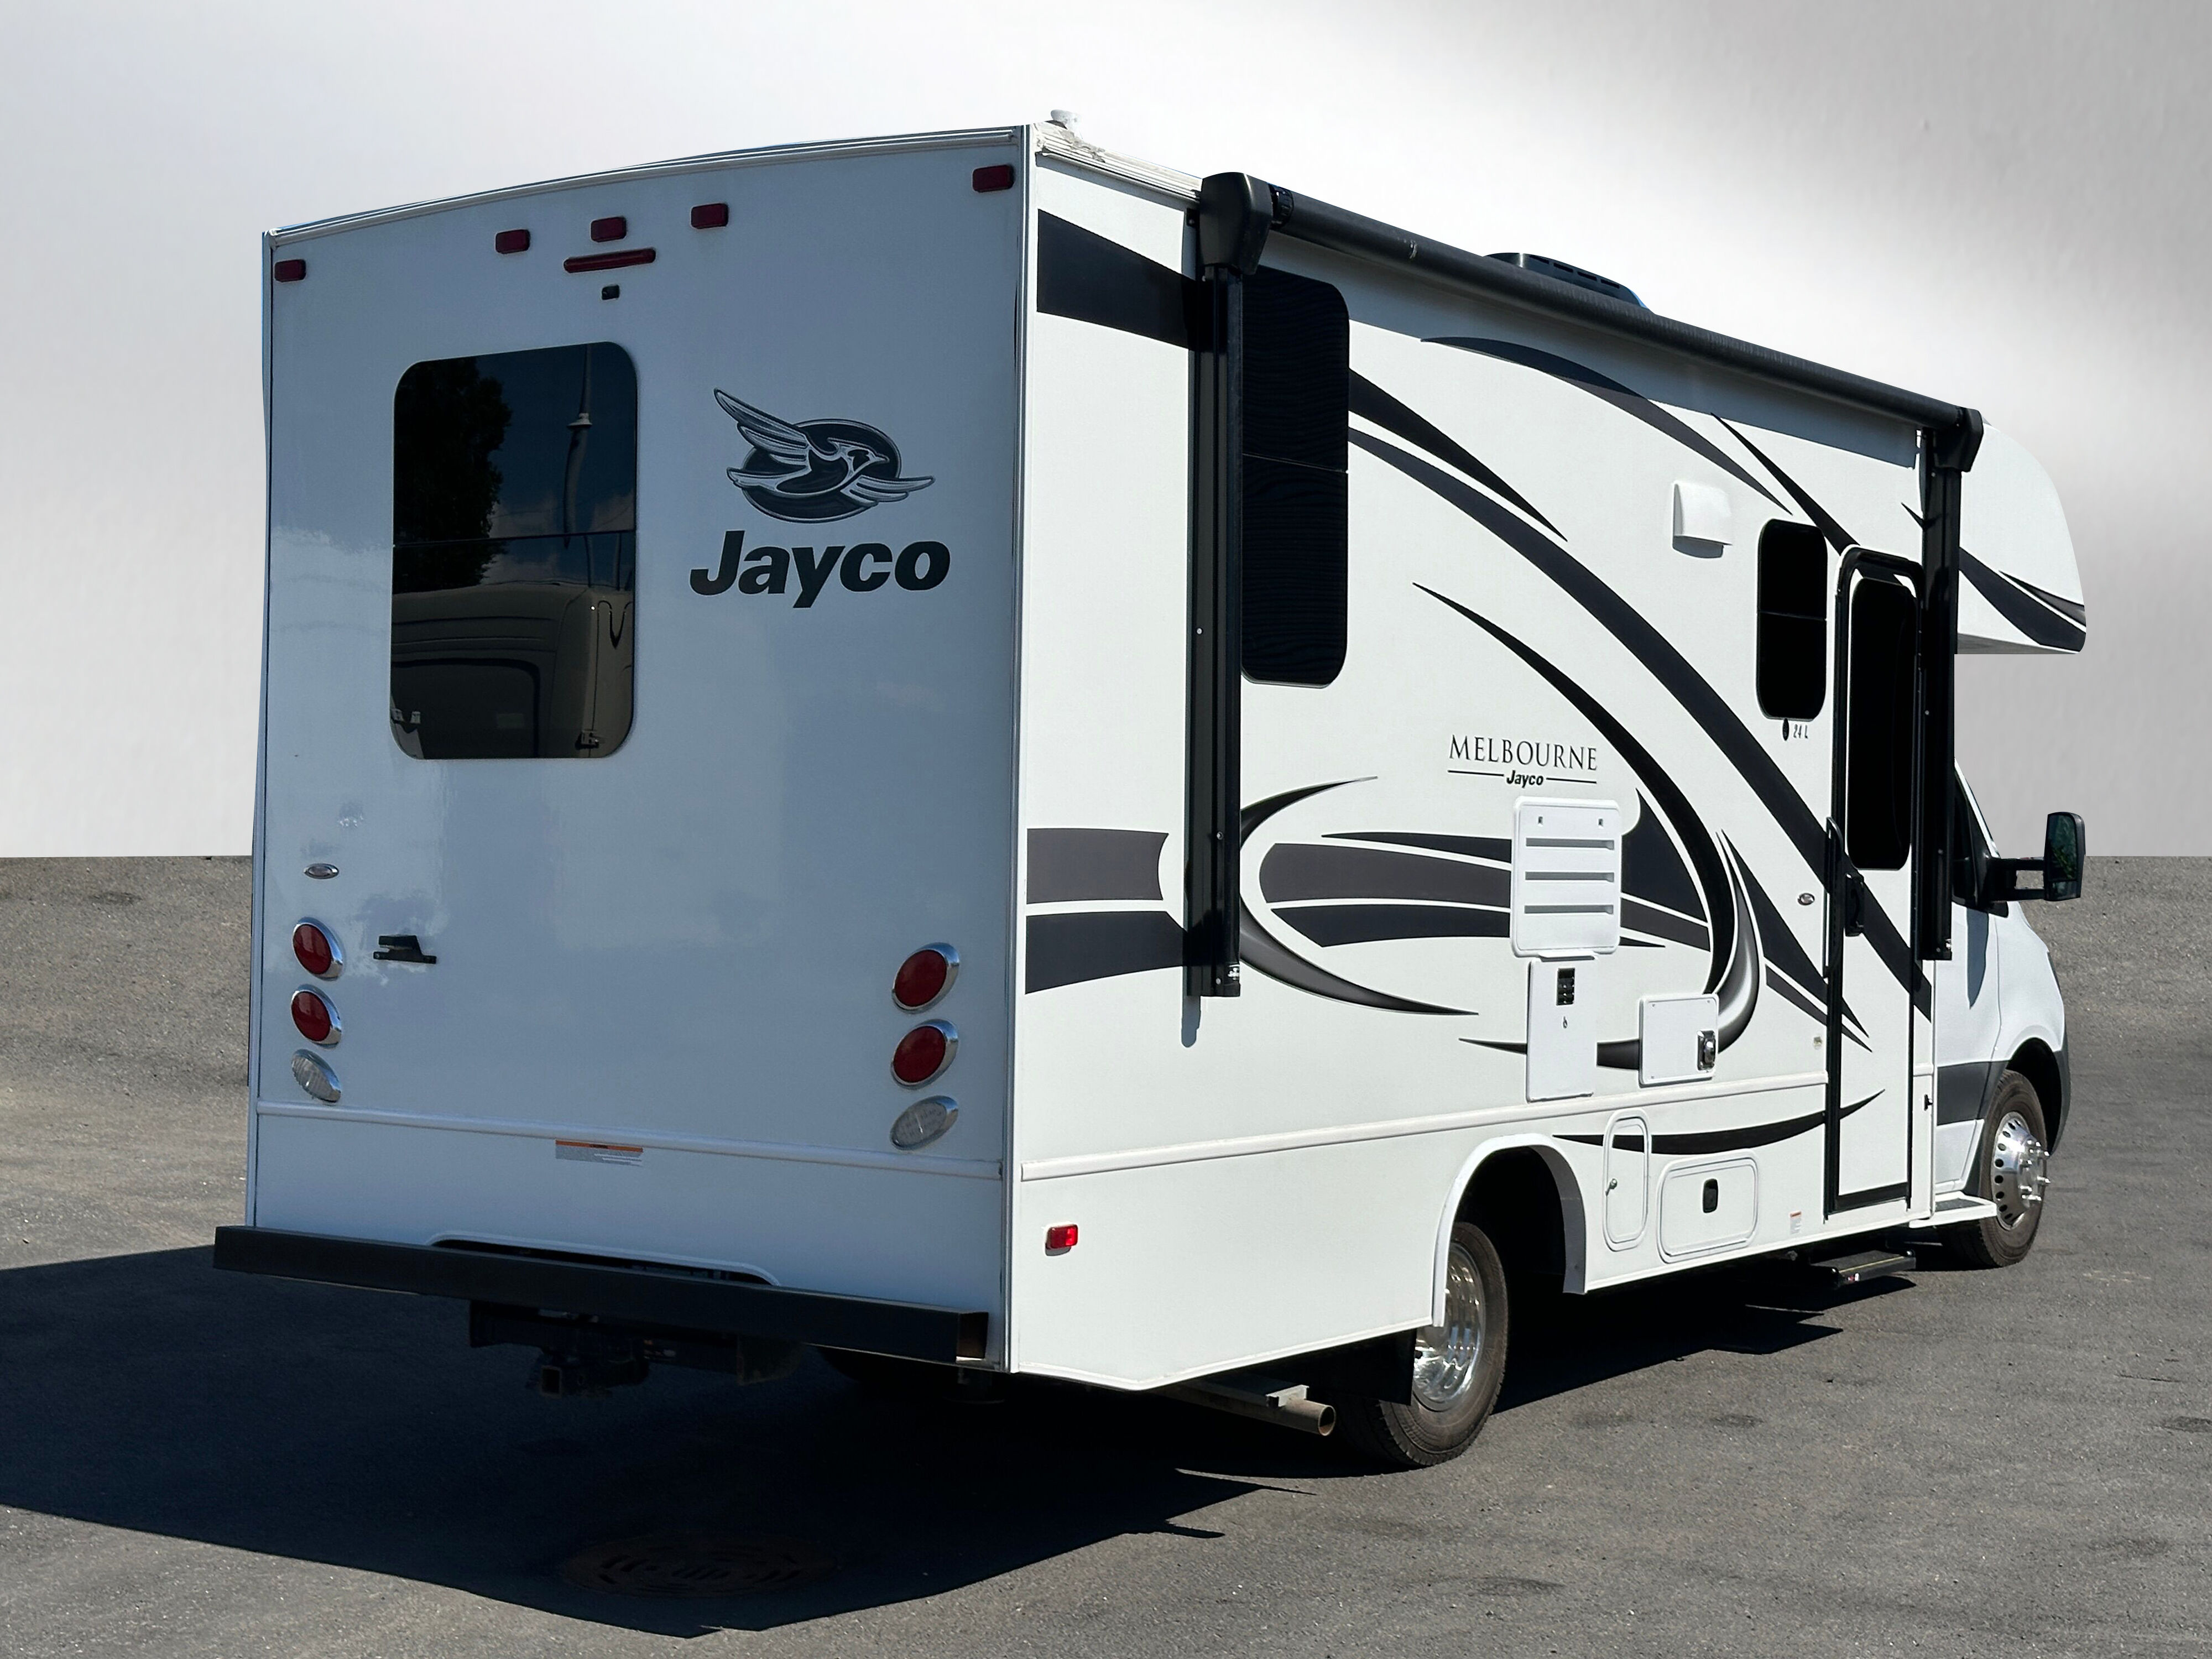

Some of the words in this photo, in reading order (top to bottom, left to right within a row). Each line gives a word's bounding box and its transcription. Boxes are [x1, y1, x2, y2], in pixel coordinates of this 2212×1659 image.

[690, 530, 951, 608] Jayco
[1449, 734, 1598, 770] MELBOURNE
[1506, 770, 1544, 788] Jayco
